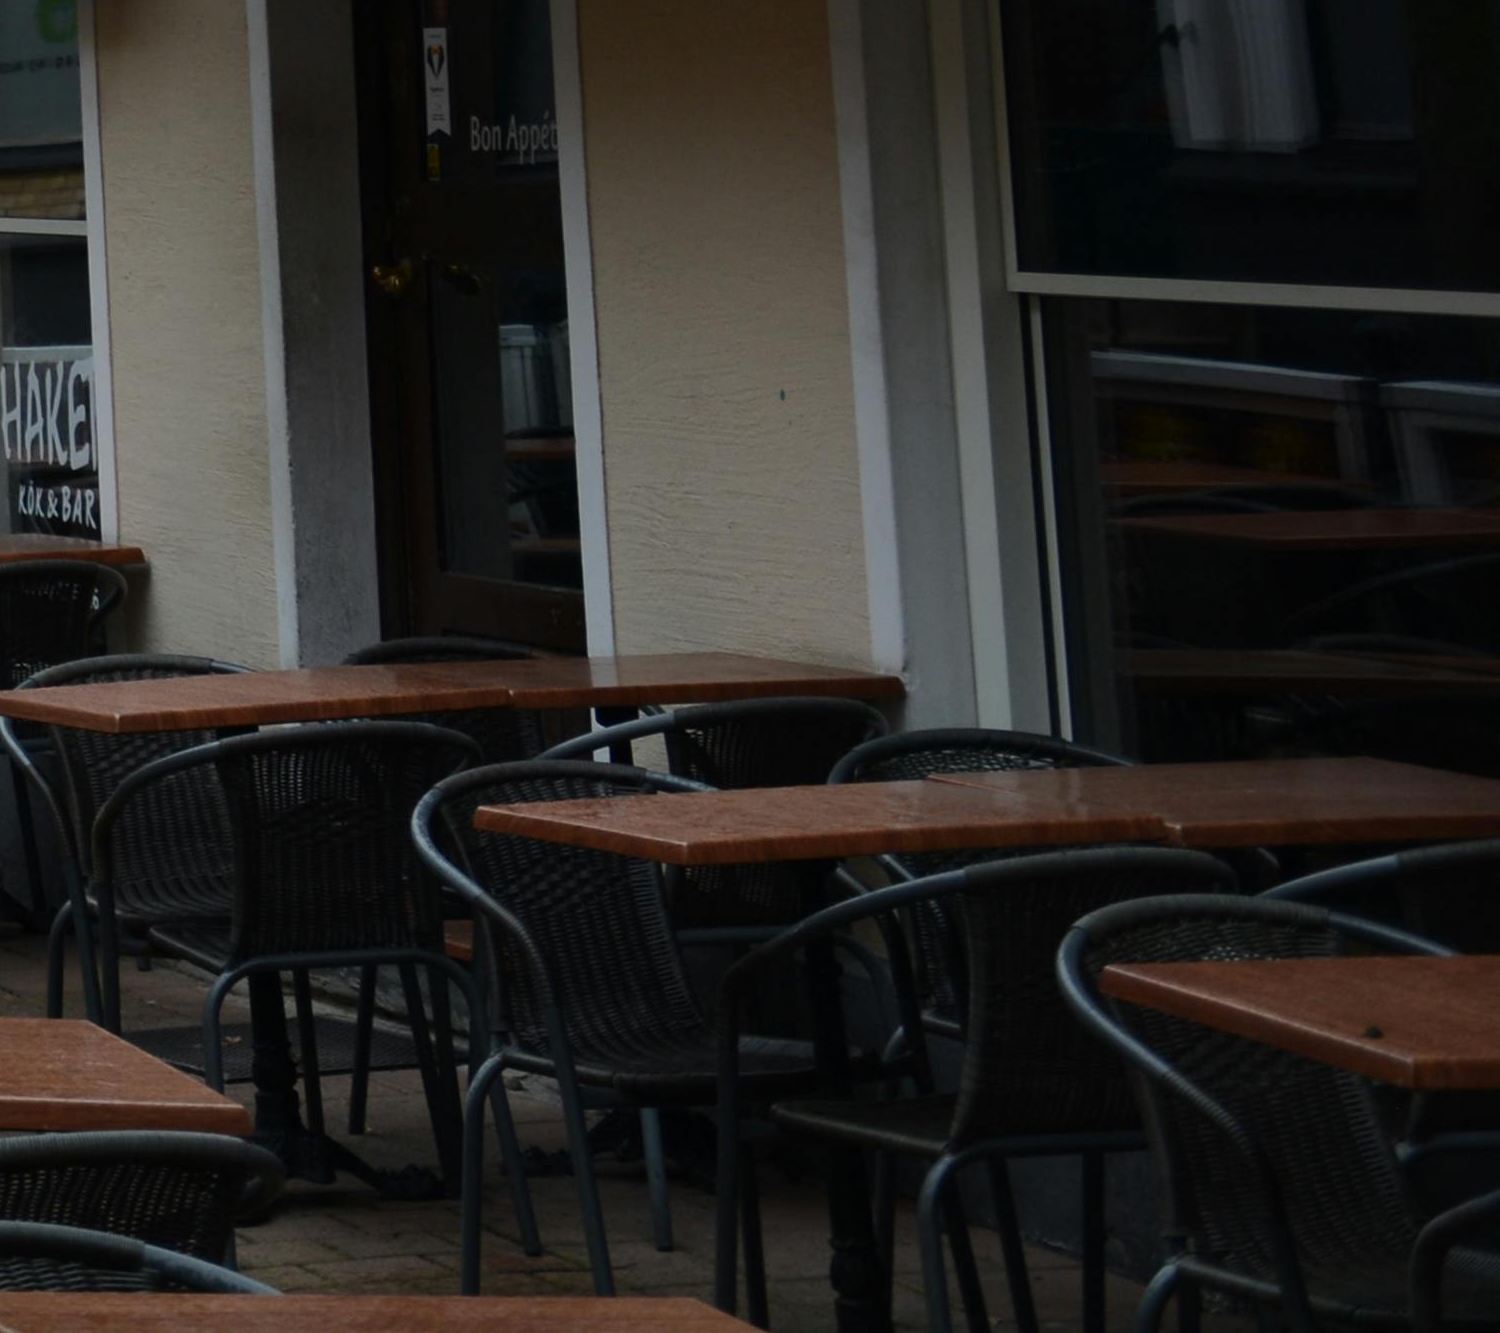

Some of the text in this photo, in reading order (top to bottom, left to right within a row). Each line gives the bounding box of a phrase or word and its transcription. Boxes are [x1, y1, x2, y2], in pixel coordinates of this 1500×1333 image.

[470, 115, 503, 152] Bon
[18, 479, 97, 530] KÖK & BAR
